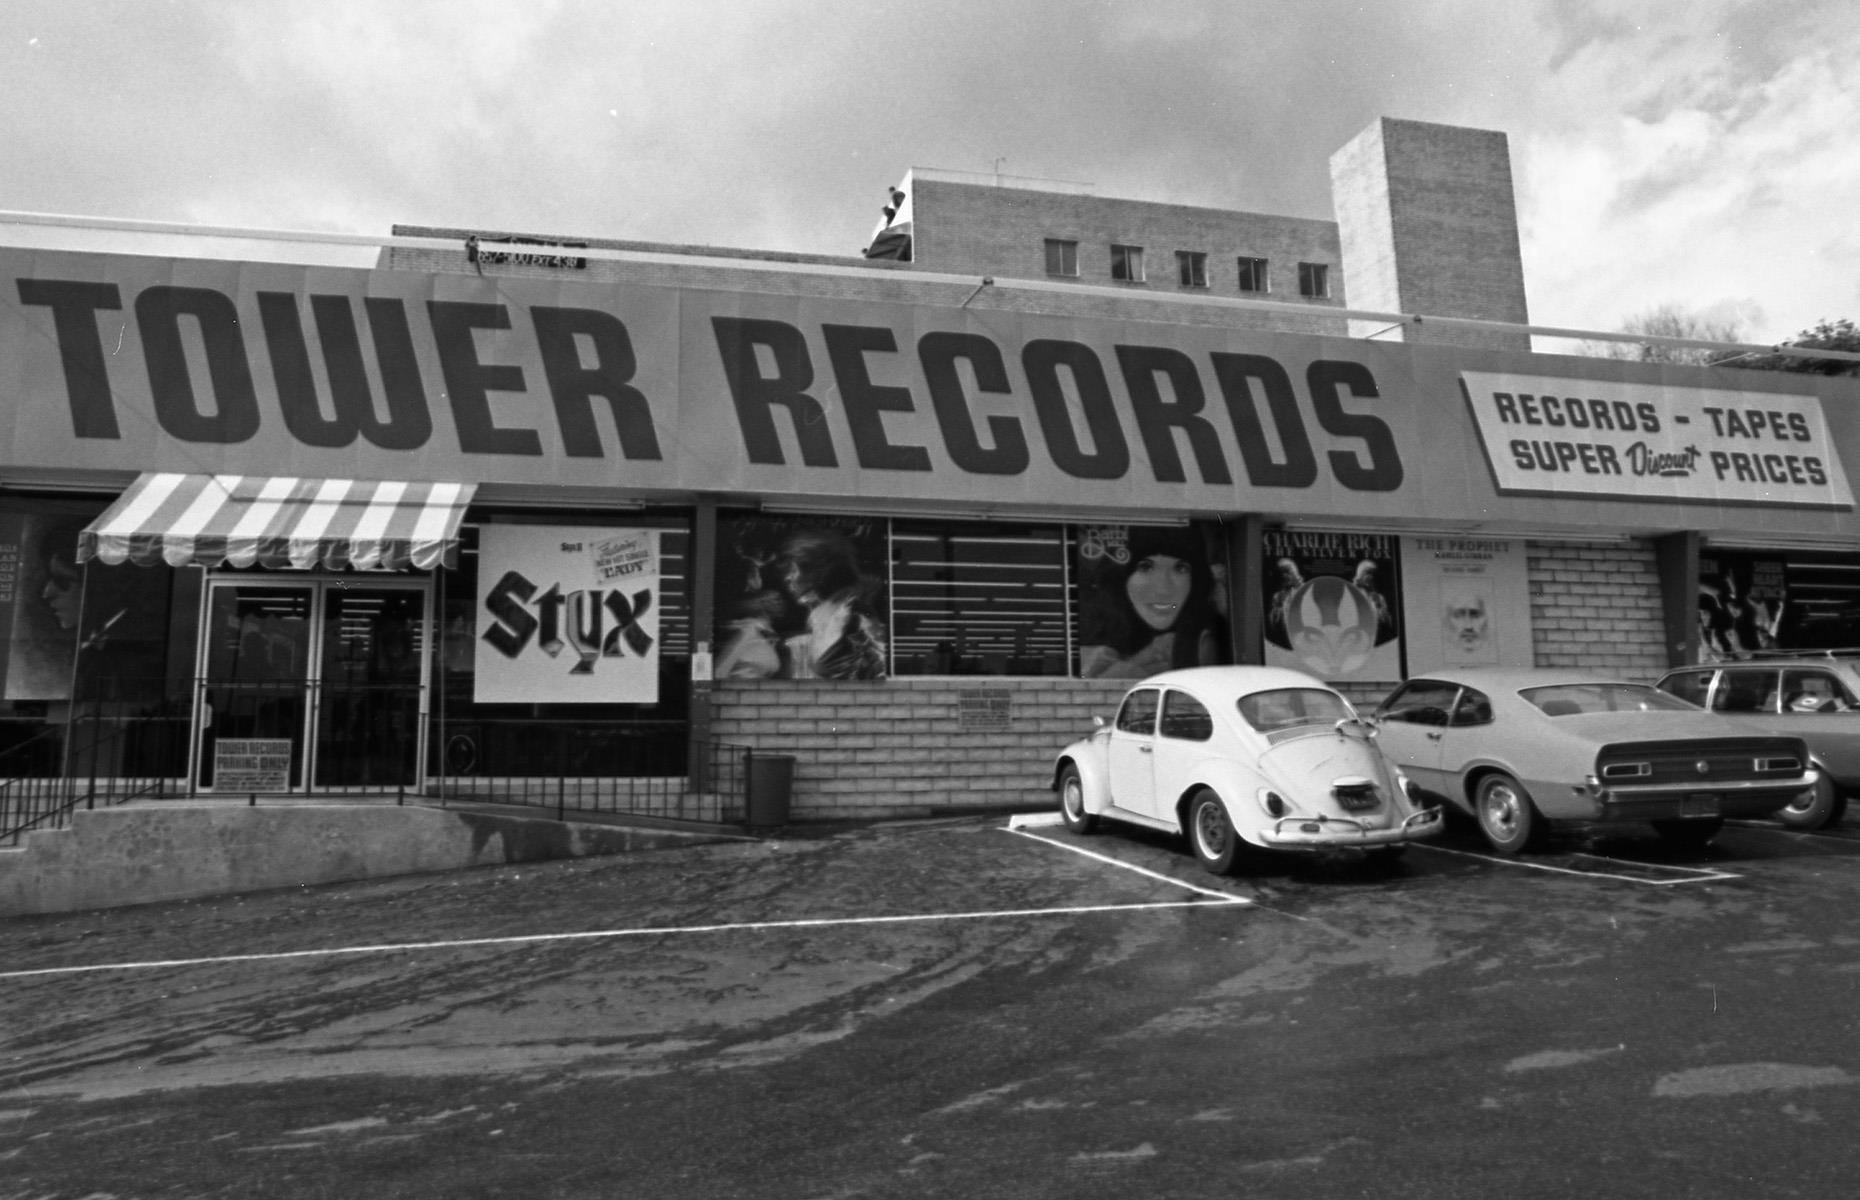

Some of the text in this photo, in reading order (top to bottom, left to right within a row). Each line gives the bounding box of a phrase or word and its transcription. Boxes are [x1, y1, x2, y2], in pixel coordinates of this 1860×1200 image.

[16, 278, 1403, 491] TOWER RECORDS
[1493, 392, 1661, 433] RECORDS
[1703, 407, 1811, 442] TAPES
[1510, 439, 1828, 486] SUPER Discount PRICES
[1263, 532, 1391, 550] CHARLIE RICH
[1265, 546, 1392, 560] THE SILVER FOX
[1416, 539, 1511, 553] THE PROPHET
[482, 570, 654, 675] Styx
[217, 756, 289, 771] PARKING ONLY
